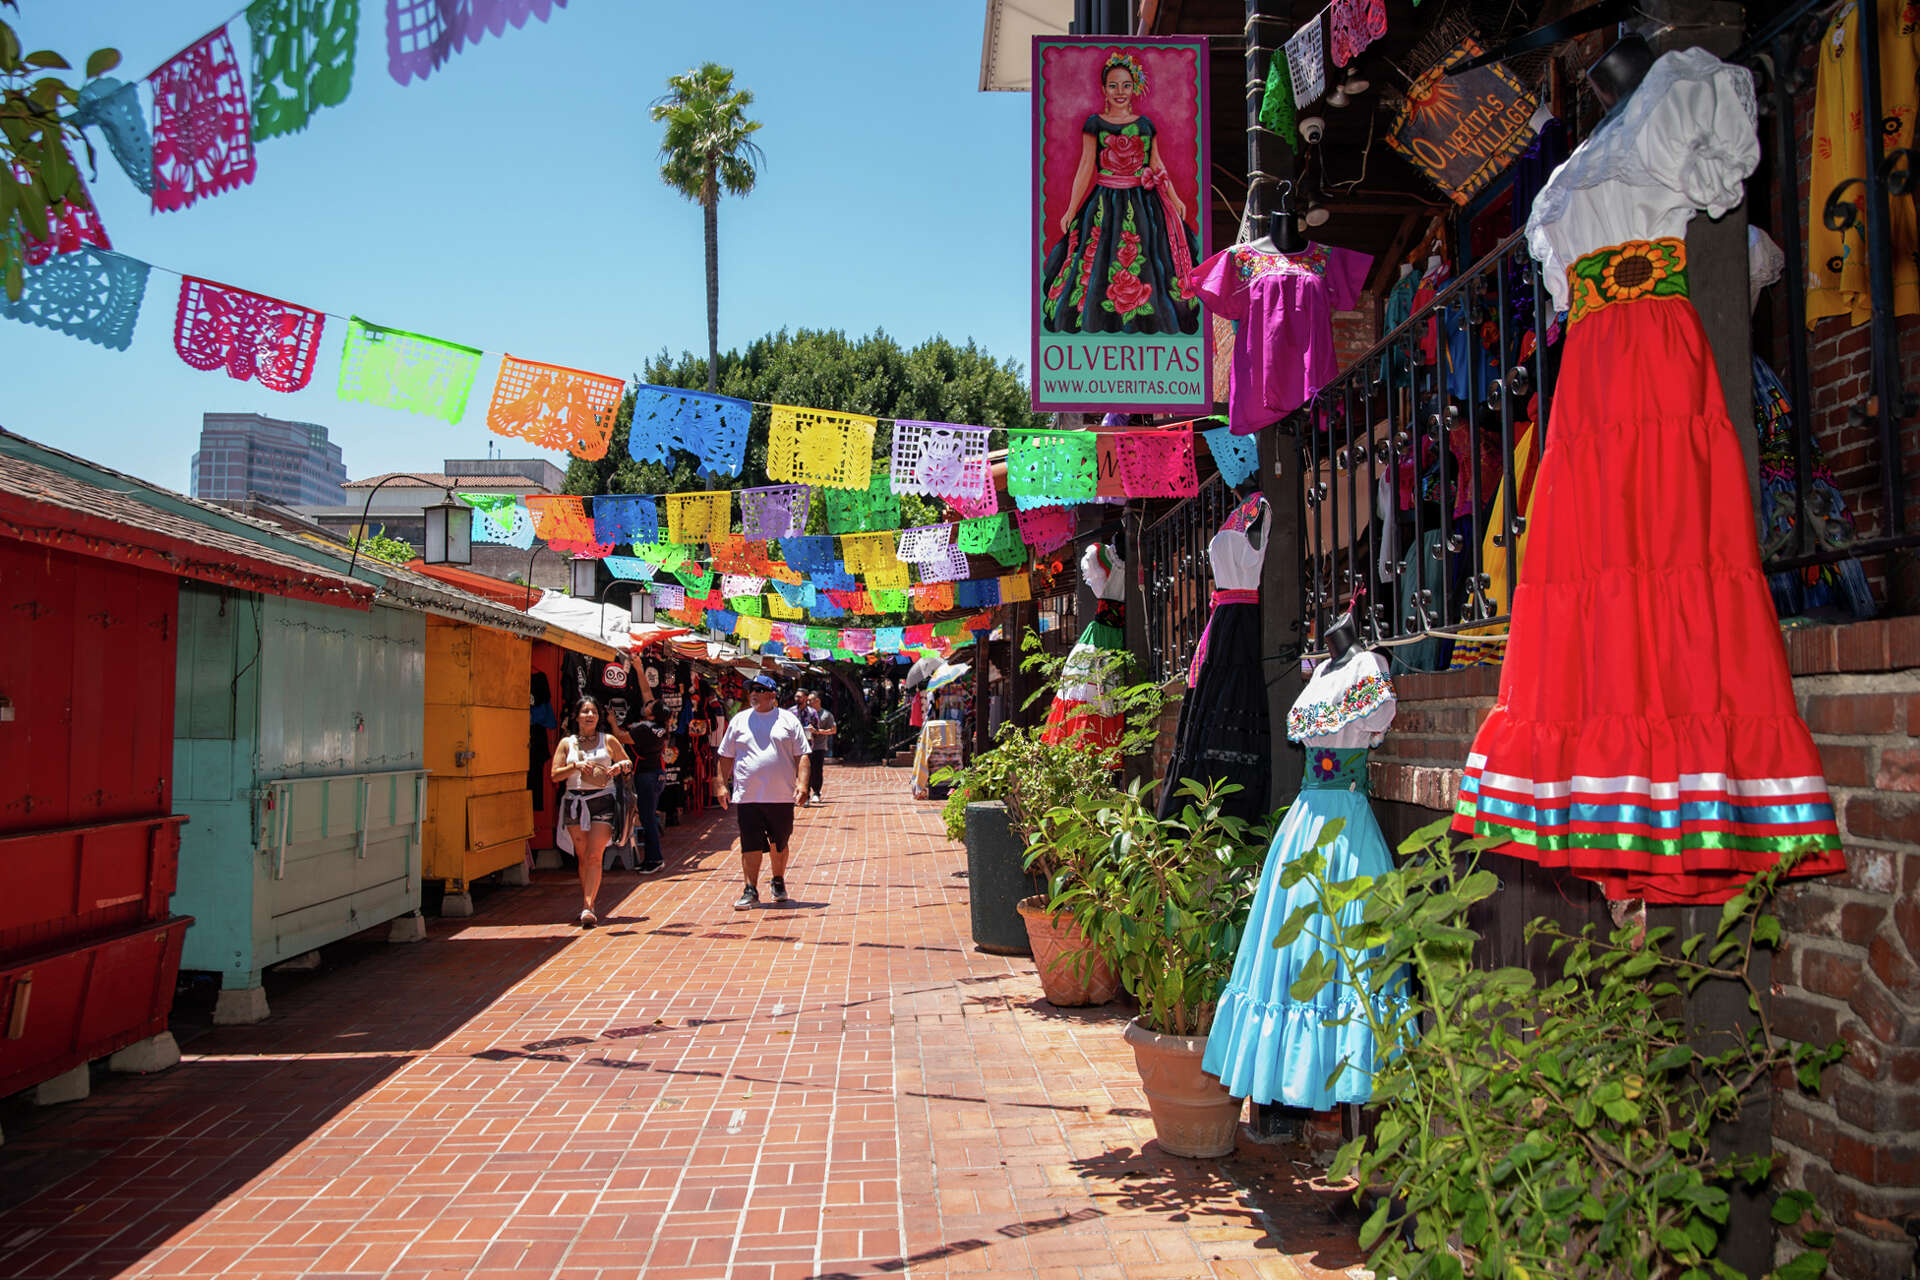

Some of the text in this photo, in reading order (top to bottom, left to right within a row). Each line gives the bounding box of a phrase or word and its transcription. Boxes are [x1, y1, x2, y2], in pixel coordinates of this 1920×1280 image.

[1464, 98, 1534, 158] VILLAGE
[1044, 345, 1200, 372] OLVERITAS
[1044, 380, 1201, 395] WWW.OLVERITAS.COM
